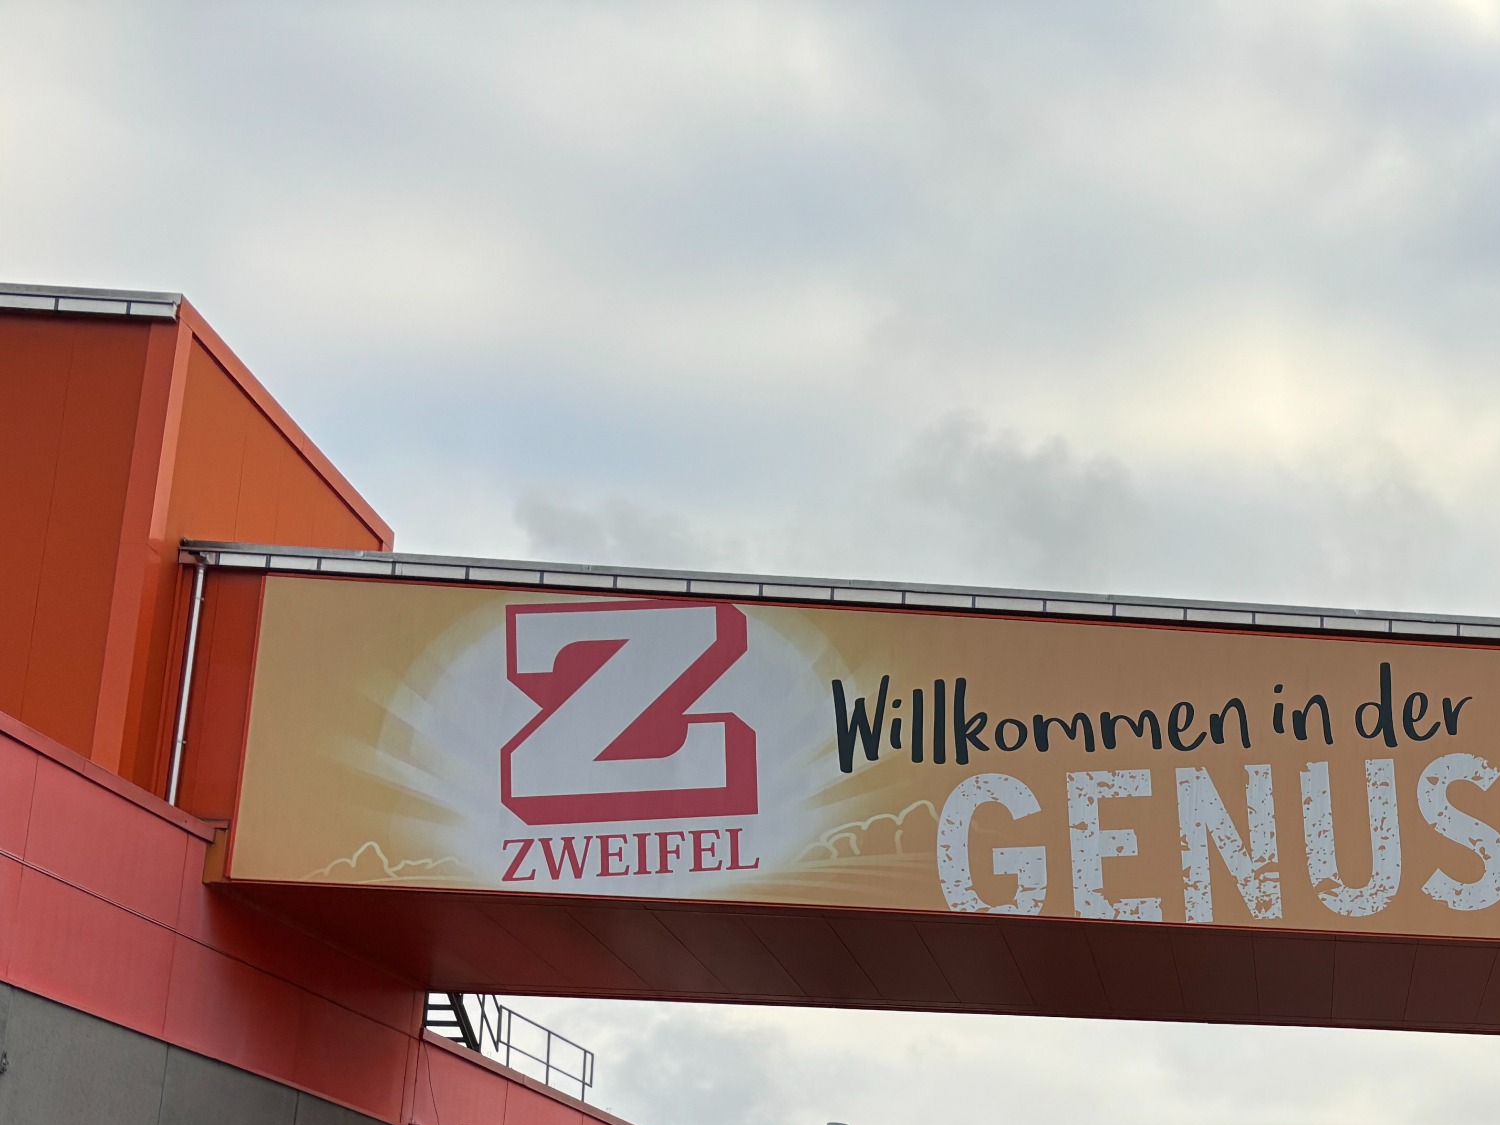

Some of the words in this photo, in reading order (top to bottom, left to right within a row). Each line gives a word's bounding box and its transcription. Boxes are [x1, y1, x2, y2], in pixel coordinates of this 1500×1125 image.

[832, 675, 1251, 773] Willkommen
[1272, 684, 1334, 745] in
[1354, 662, 1473, 748] der
[502, 828, 760, 882] ZWEIFEL
